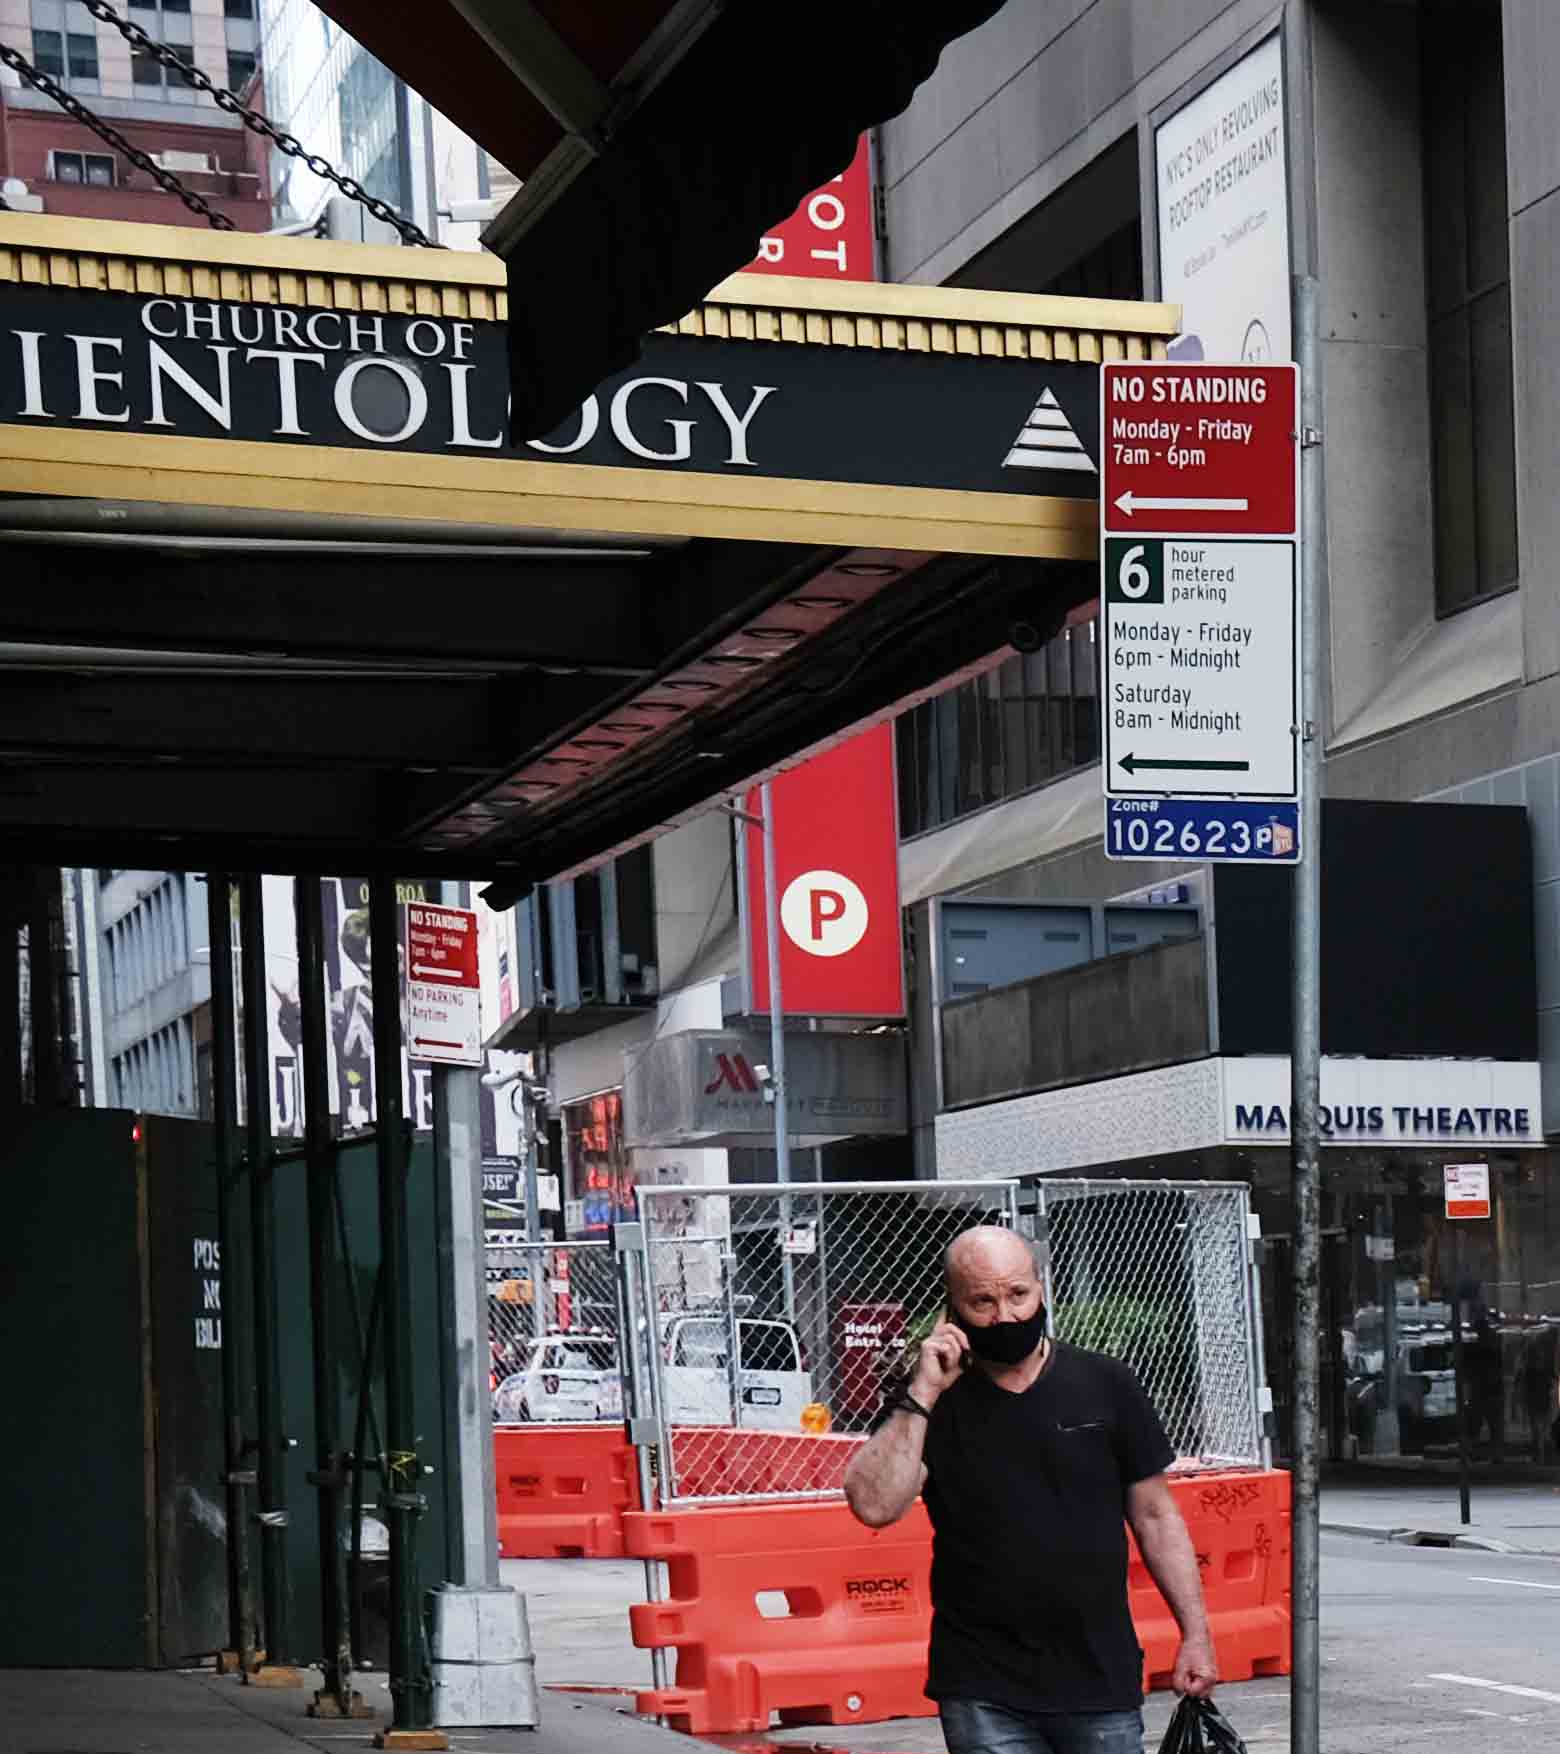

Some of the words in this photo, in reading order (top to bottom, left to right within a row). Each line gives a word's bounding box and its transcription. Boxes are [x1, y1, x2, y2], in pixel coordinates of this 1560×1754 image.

[1221, 77, 1279, 140] REVOLVING
[1169, 177, 1211, 232] ROOFTOP
[1215, 126, 1278, 197] RESTAURANT
[141, 300, 383, 353] CHURCH
[405, 320, 474, 358] OF
[1112, 377, 1145, 402] NO
[1152, 377, 1267, 404] STANDING
[1112, 418, 1181, 443] Monday
[1198, 418, 1253, 445] Friday
[1113, 445, 1150, 465] 7am
[1167, 445, 1206, 470] 6pm
[1171, 546, 1206, 564] hour
[1119, 544, 1150, 600] 6
[1171, 566, 1235, 582] metered
[1171, 584, 1227, 604] parking
[1114, 621, 1181, 646] Monday
[1199, 622, 1253, 647] Friday
[1114, 647, 1151, 670] 6pm
[1170, 648, 1241, 672] Midnight
[1115, 683, 1192, 708] Saturday
[1115, 709, 1152, 729] 8am
[1170, 711, 1241, 733] Midnight
[1111, 800, 1159, 813] Zone#
[1112, 817, 1251, 854] 102623
[410, 909, 424, 926] NO
[424, 912, 468, 933] STANDING
[809, 889, 846, 941] P
[411, 987, 424, 1001] NO
[426, 988, 464, 1007] PARKING
[411, 1006, 448, 1024] Anytime
[1235, 1104, 1385, 1135] MAQUIS
[1391, 1106, 1530, 1133] THEATRE
[845, 1323, 881, 1334] Hotel
[846, 1578, 909, 1594] ROCK
